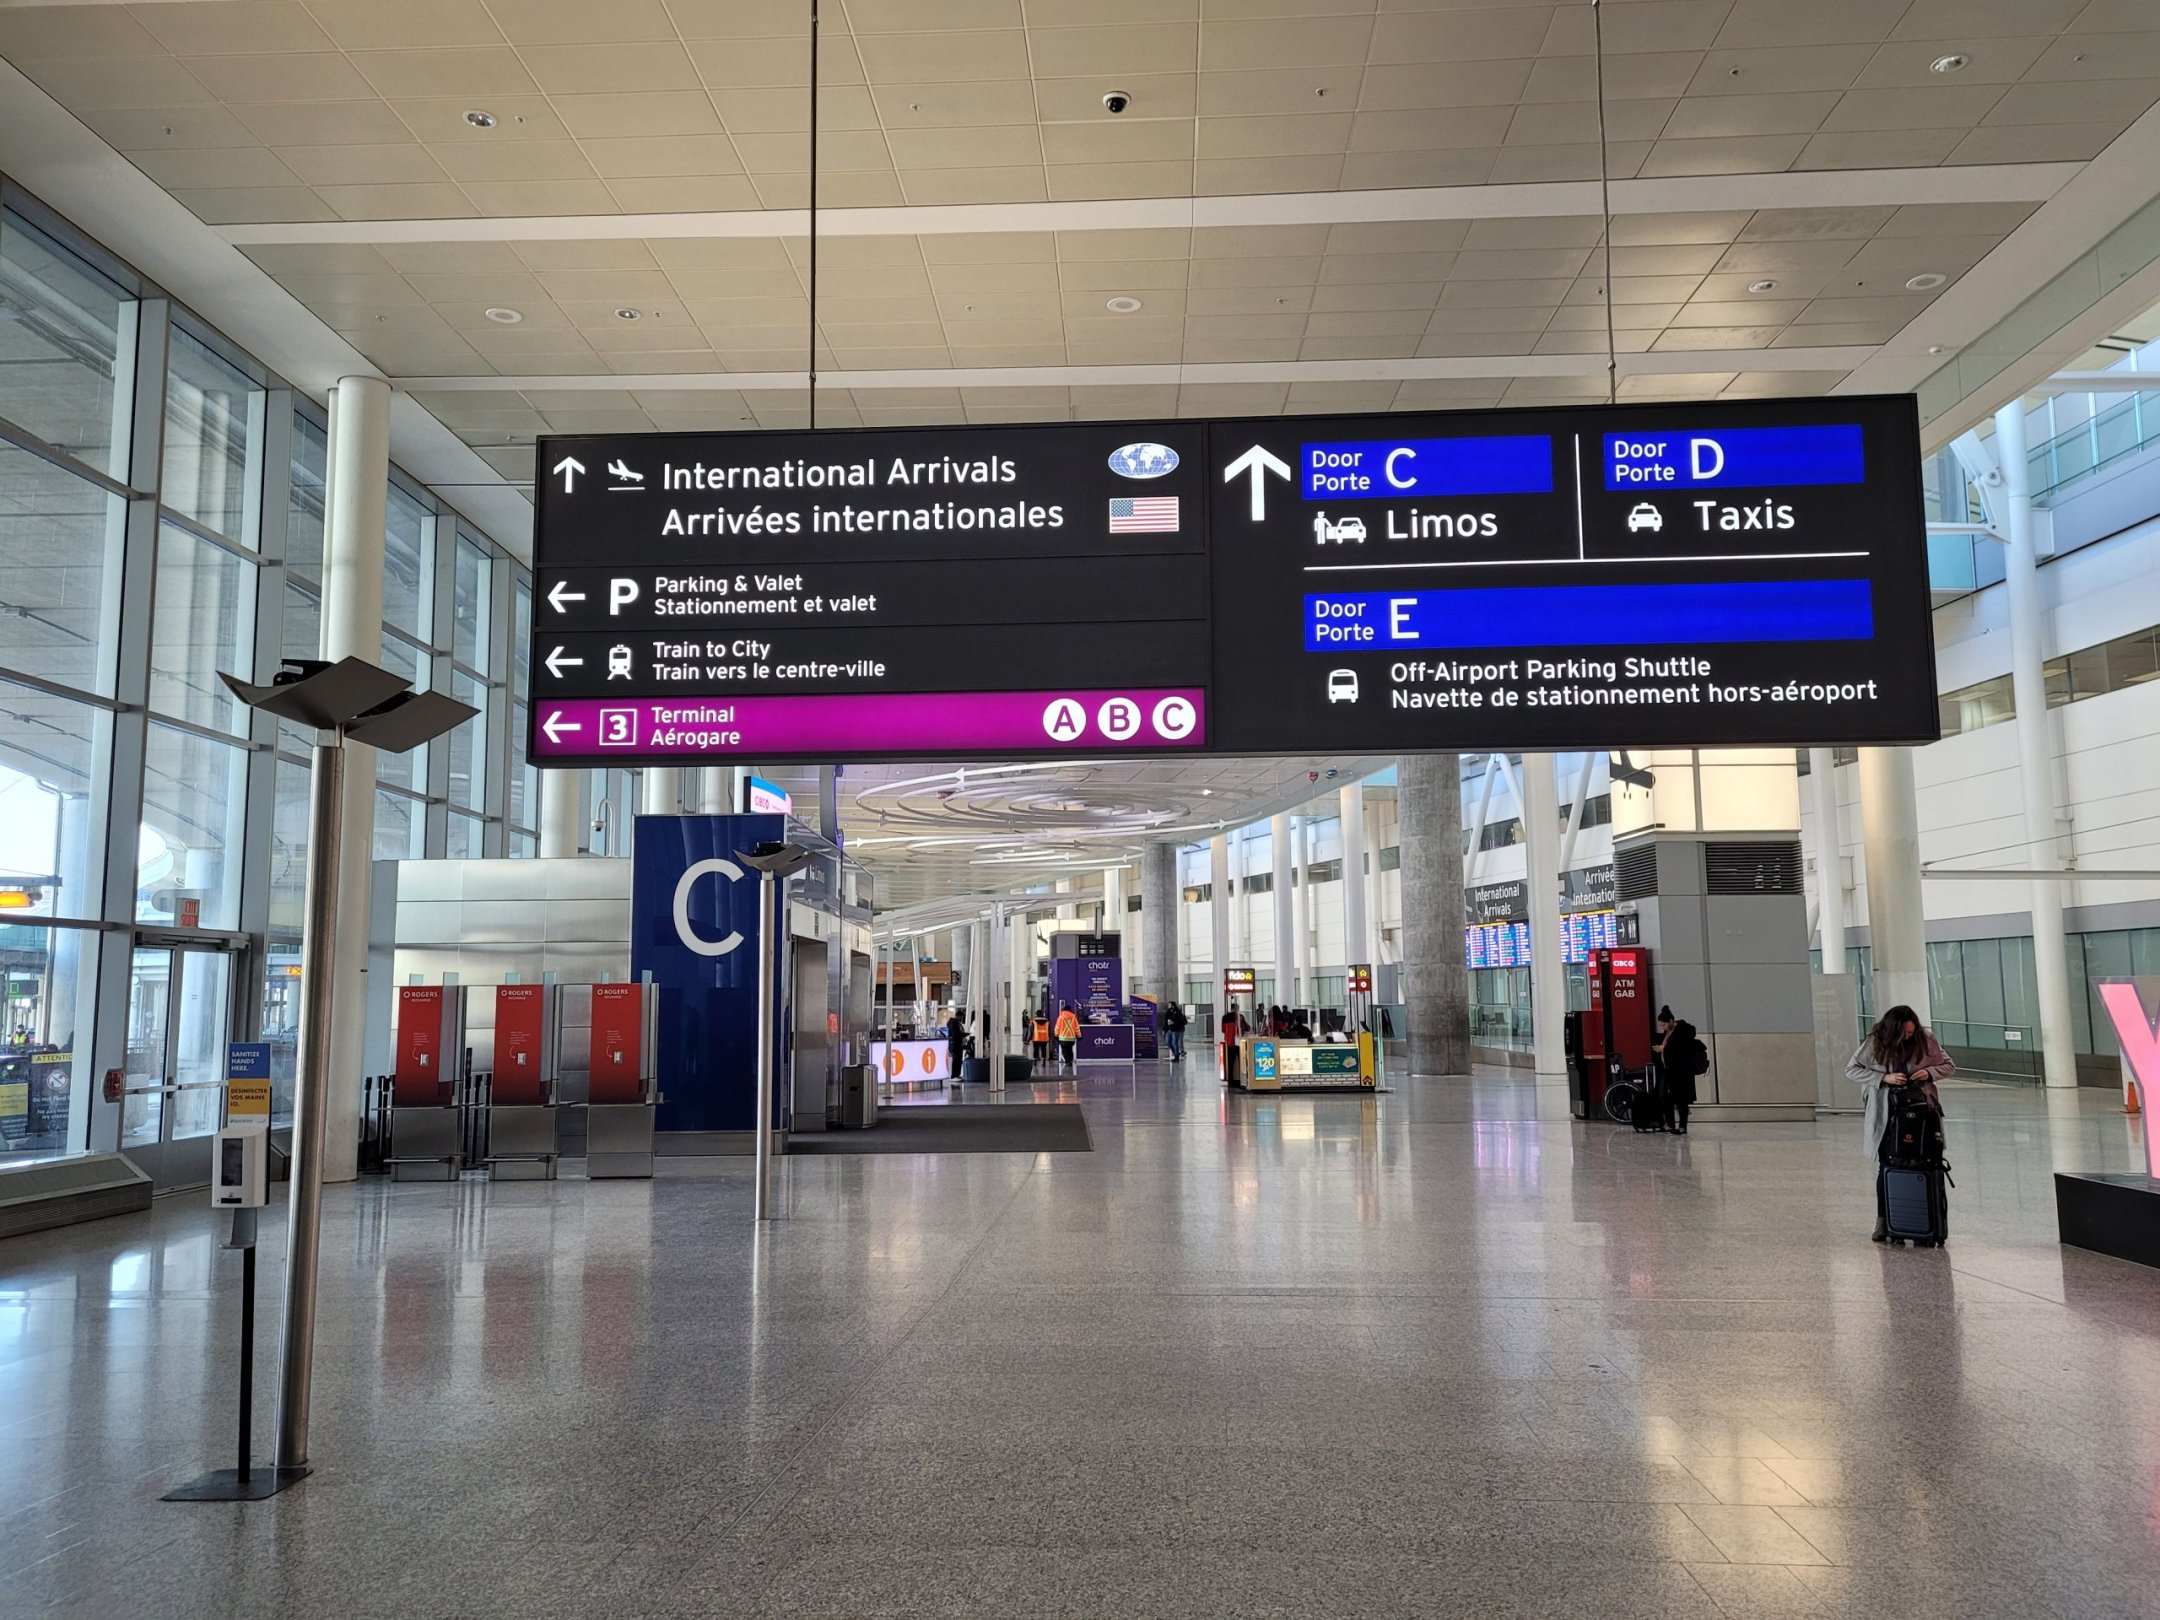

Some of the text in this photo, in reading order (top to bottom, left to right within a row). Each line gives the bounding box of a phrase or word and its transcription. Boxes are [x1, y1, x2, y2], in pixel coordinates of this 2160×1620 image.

[1313, 450, 1363, 468] Door
[1615, 440, 1667, 458] Door
[1690, 439, 1725, 480] D
[663, 456, 1017, 490] International Arrivals
[1385, 447, 1418, 489] C
[1616, 463, 1676, 482] Porte
[1313, 473, 1371, 492] Porte
[661, 500, 1064, 536] Arrivées internationales
[1387, 508, 1498, 540] Limos
[1693, 498, 1795, 530] Taxis
[655, 574, 803, 596] Parking & Valet
[609, 578, 640, 616] P
[654, 594, 877, 616] Stationnement et valet
[1316, 600, 1367, 618] Door
[1390, 598, 1420, 640] E
[1316, 623, 1375, 642] Porte
[652, 640, 771, 661] Train to City
[651, 660, 886, 681] Train vers le centre-ville
[1390, 657, 1711, 685] Off-Airport Parking Shuttle
[1392, 680, 1878, 709] Navette de stationnement hors-aéroport
[651, 706, 734, 724] Terminal
[1052, 706, 1077, 734] A
[1108, 705, 1131, 733] B
[1162, 703, 1186, 733] C
[608, 714, 628, 741] 3
[650, 727, 741, 749] Aérogare
[1475, 884, 1520, 903] International
[673, 858, 744, 956] C
[1484, 902, 1512, 918] Arrivals
[1614, 979, 1635, 988] ATM
[1614, 989, 1636, 998] GAB
